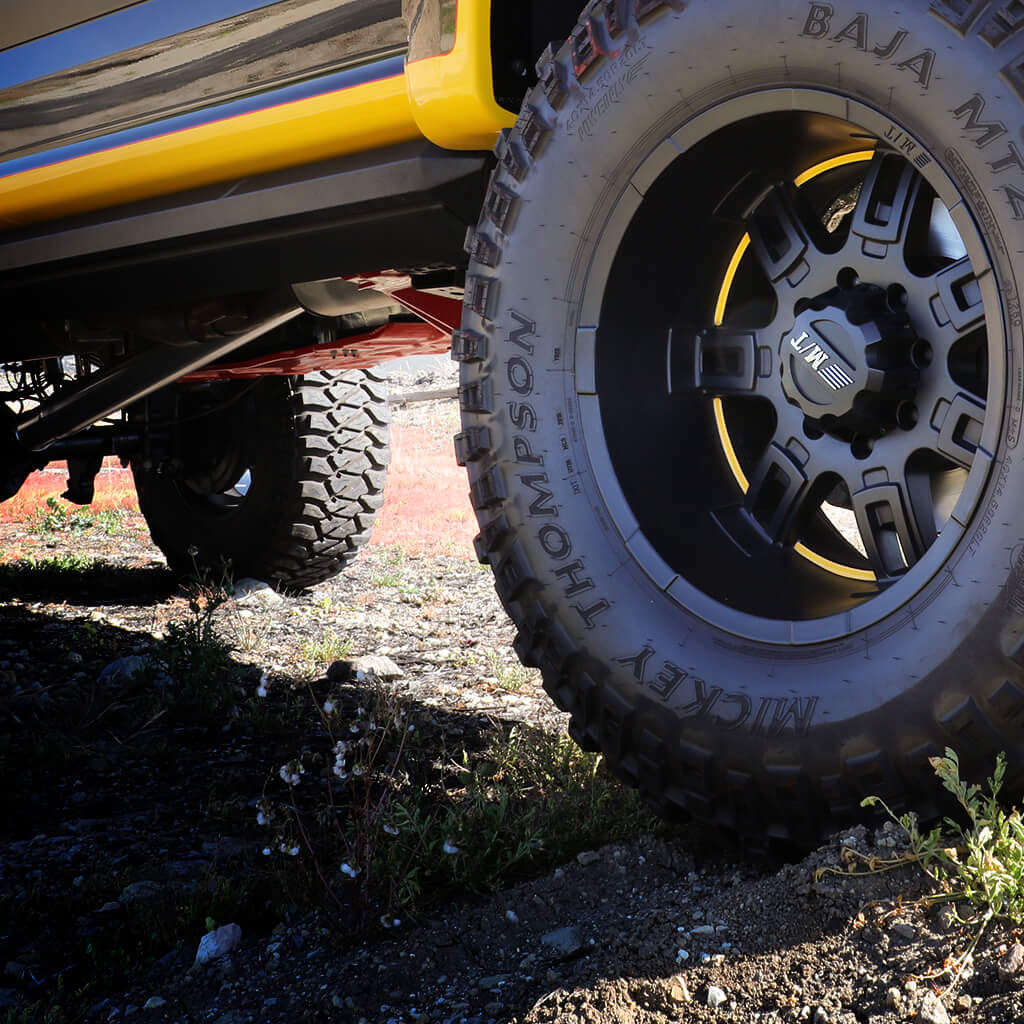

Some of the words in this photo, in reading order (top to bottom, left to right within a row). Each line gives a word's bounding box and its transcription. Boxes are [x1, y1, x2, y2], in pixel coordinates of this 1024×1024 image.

[801, 1, 938, 88] BAJA
[790, 331, 829, 371] M/T
[506, 310, 614, 631] THOMPSON
[613, 644, 820, 737] MICKEY
